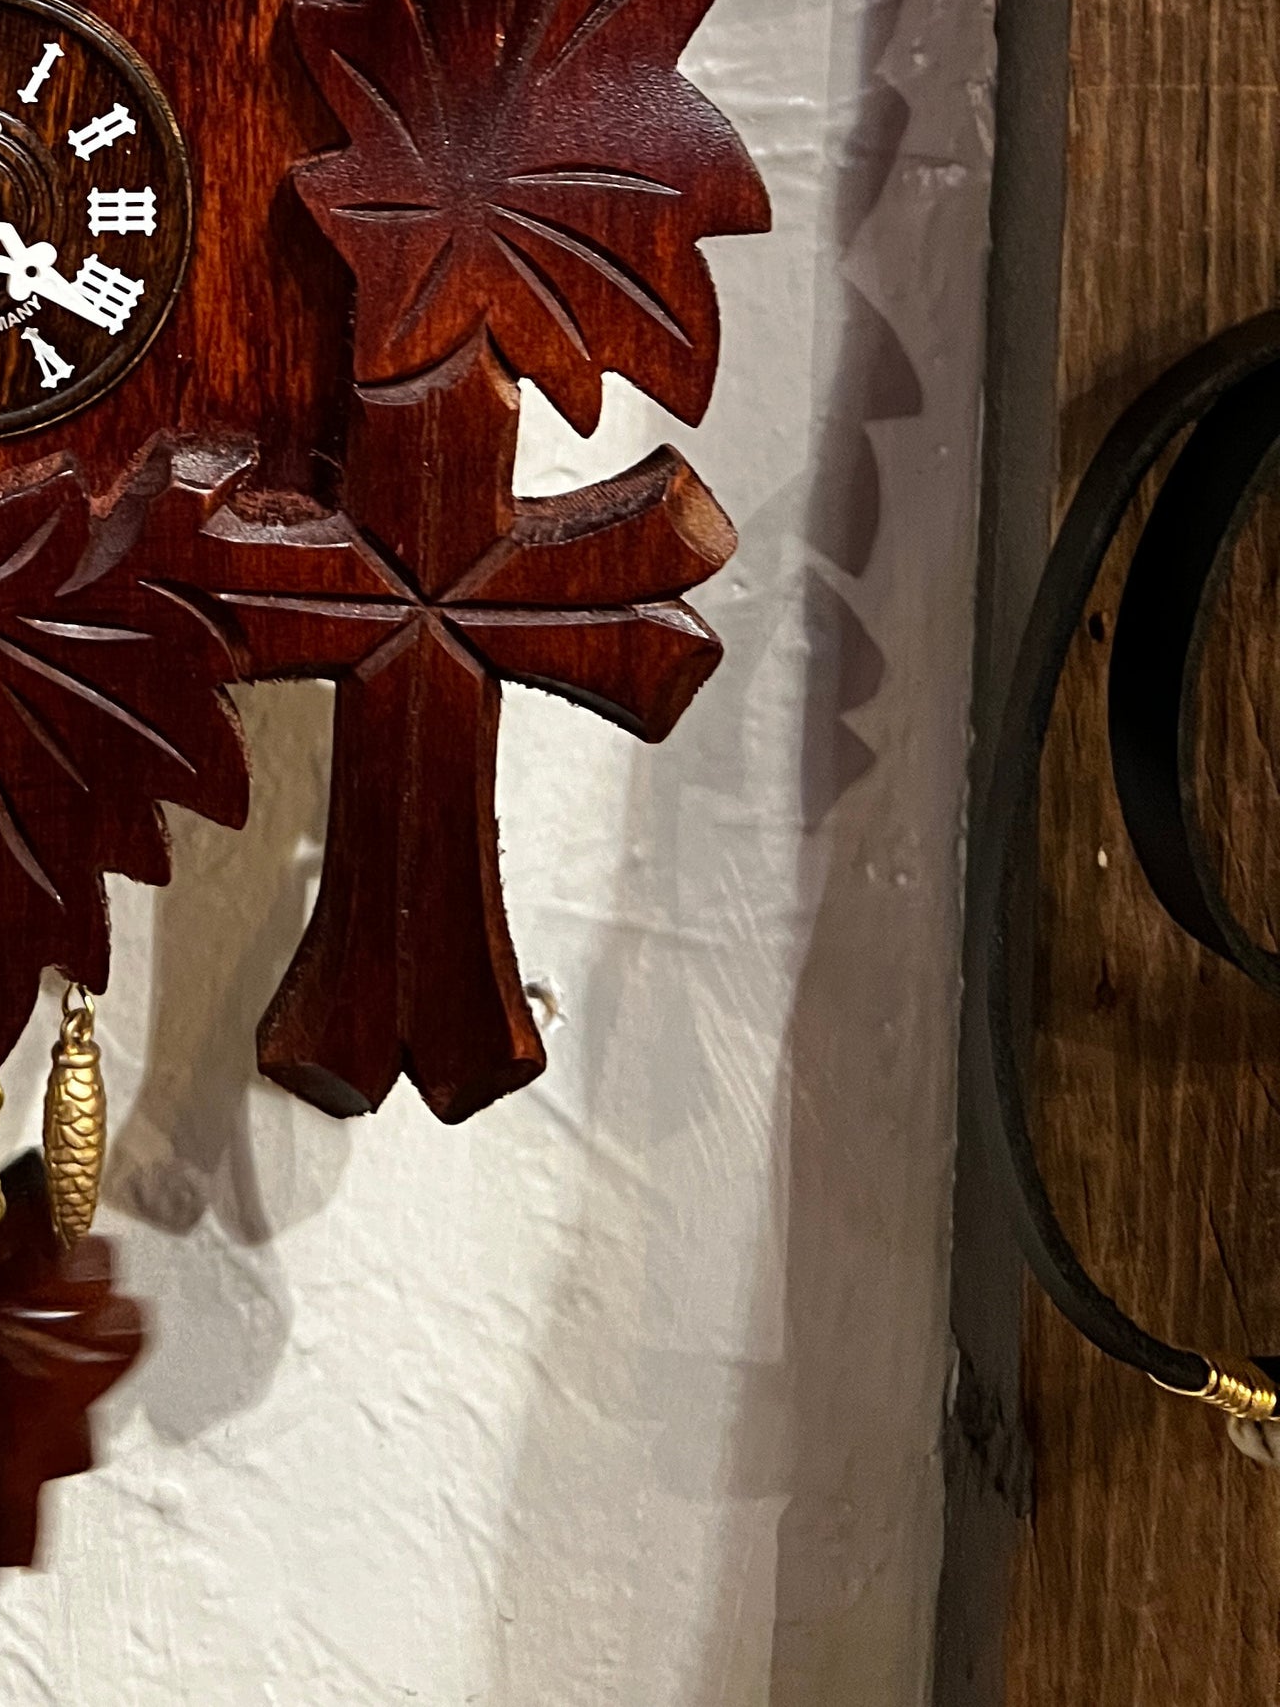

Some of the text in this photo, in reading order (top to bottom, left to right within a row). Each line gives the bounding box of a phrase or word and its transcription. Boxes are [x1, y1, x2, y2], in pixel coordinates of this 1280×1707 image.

[68, 103, 136, 161] II
[87, 186, 156, 236] III
[21, 327, 75, 388] V
